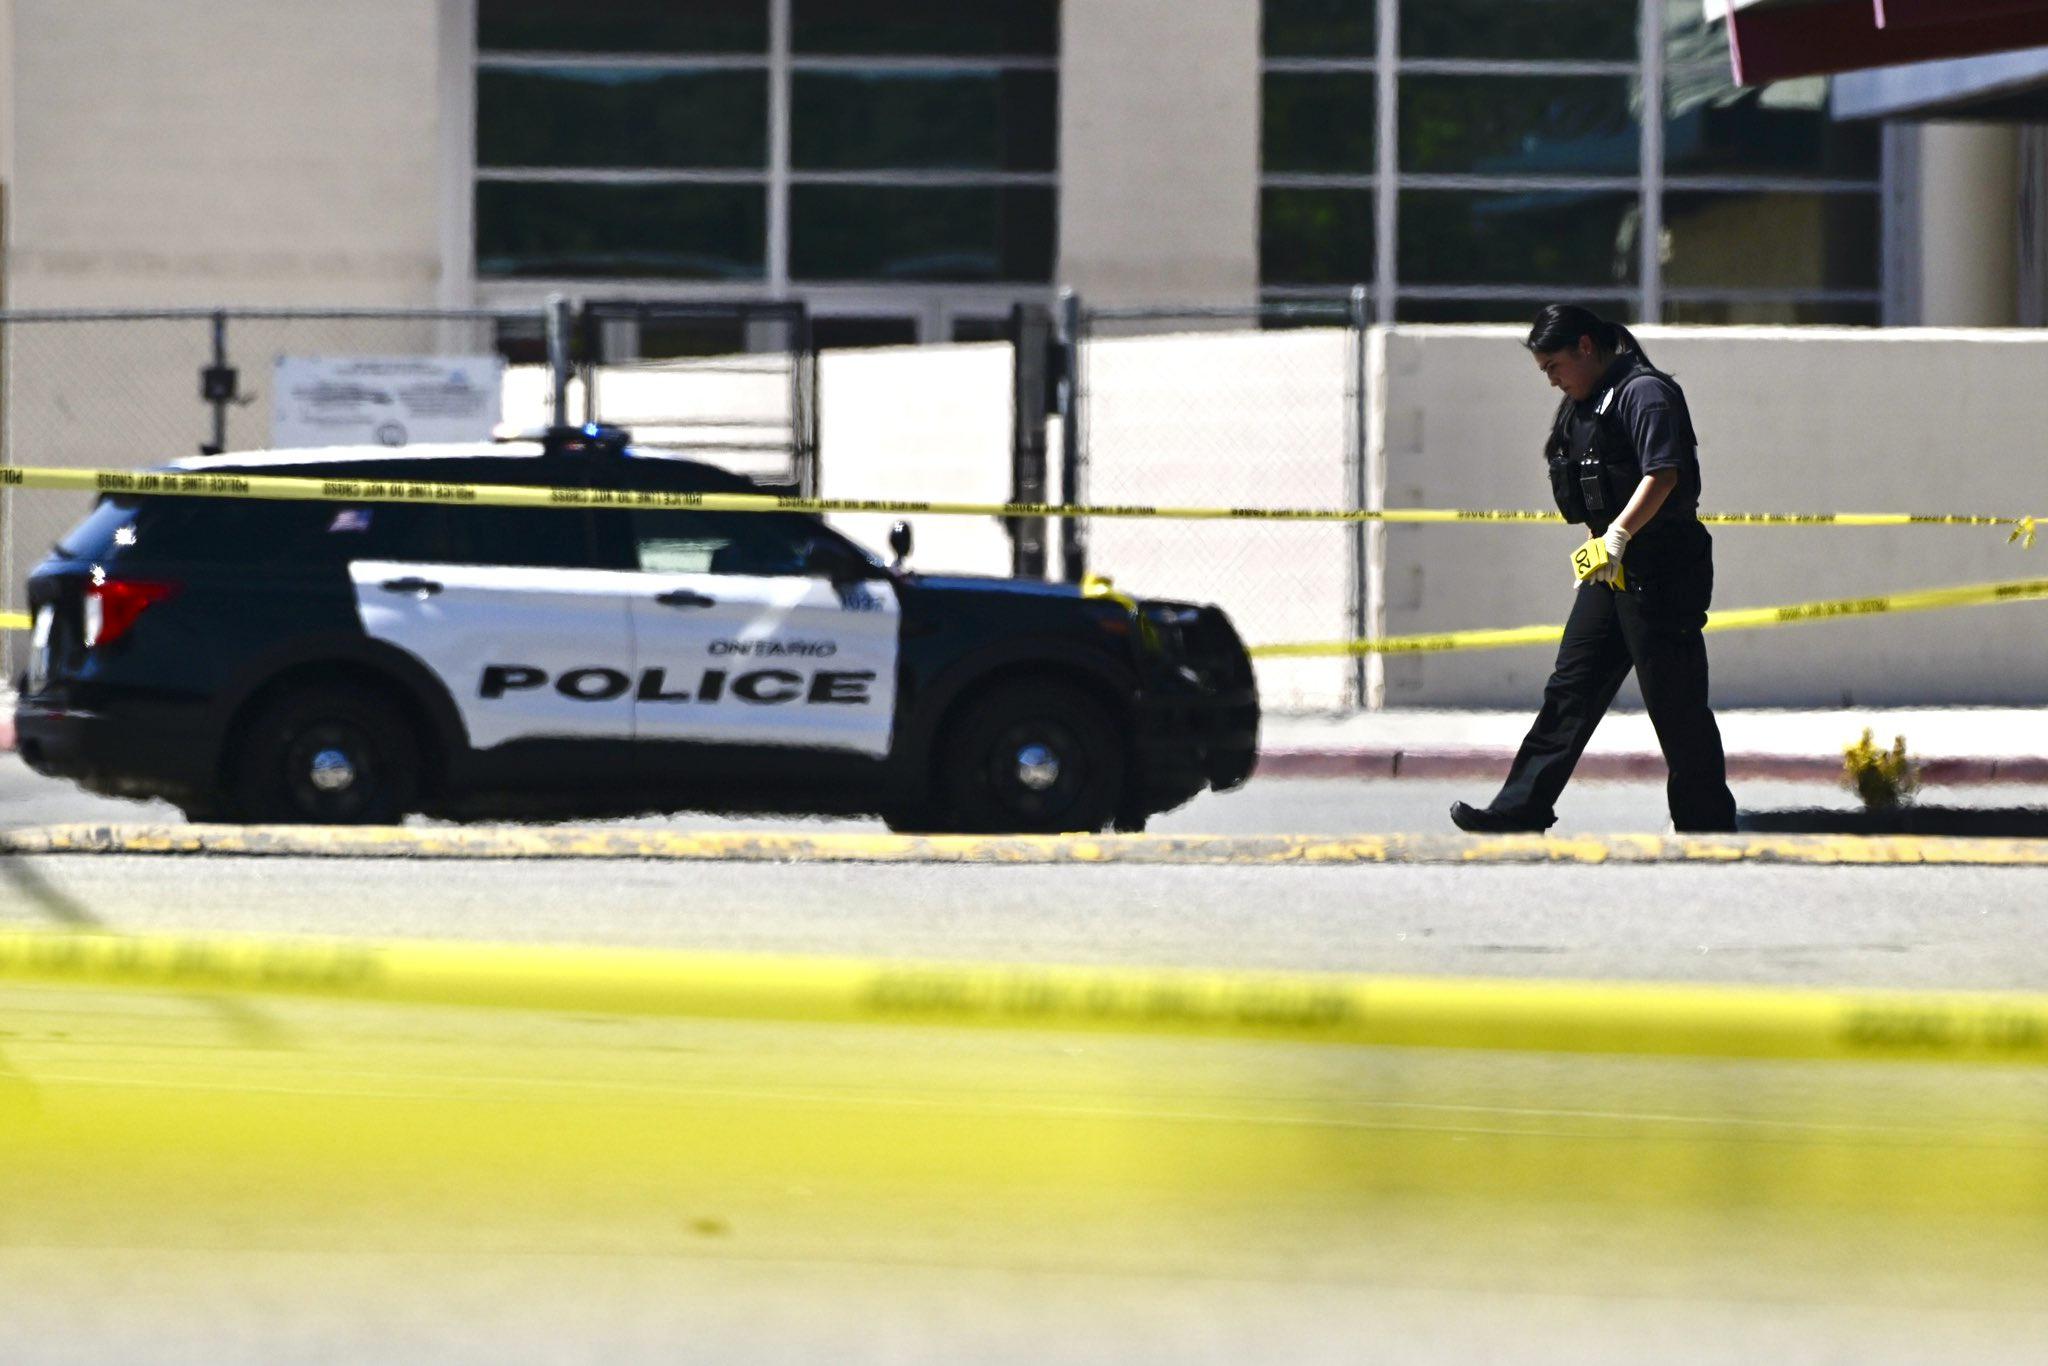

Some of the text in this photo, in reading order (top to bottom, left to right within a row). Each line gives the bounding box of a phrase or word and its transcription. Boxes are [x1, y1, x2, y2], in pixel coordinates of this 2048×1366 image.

[98, 472, 134, 489] CROSS
[138, 473, 160, 490] NOT
[182, 475, 207, 491] LINE
[211, 476, 249, 493] POLICE
[1575, 548, 1591, 574] 20
[707, 639, 838, 659] ONTARIO
[479, 664, 878, 705] POLICE
